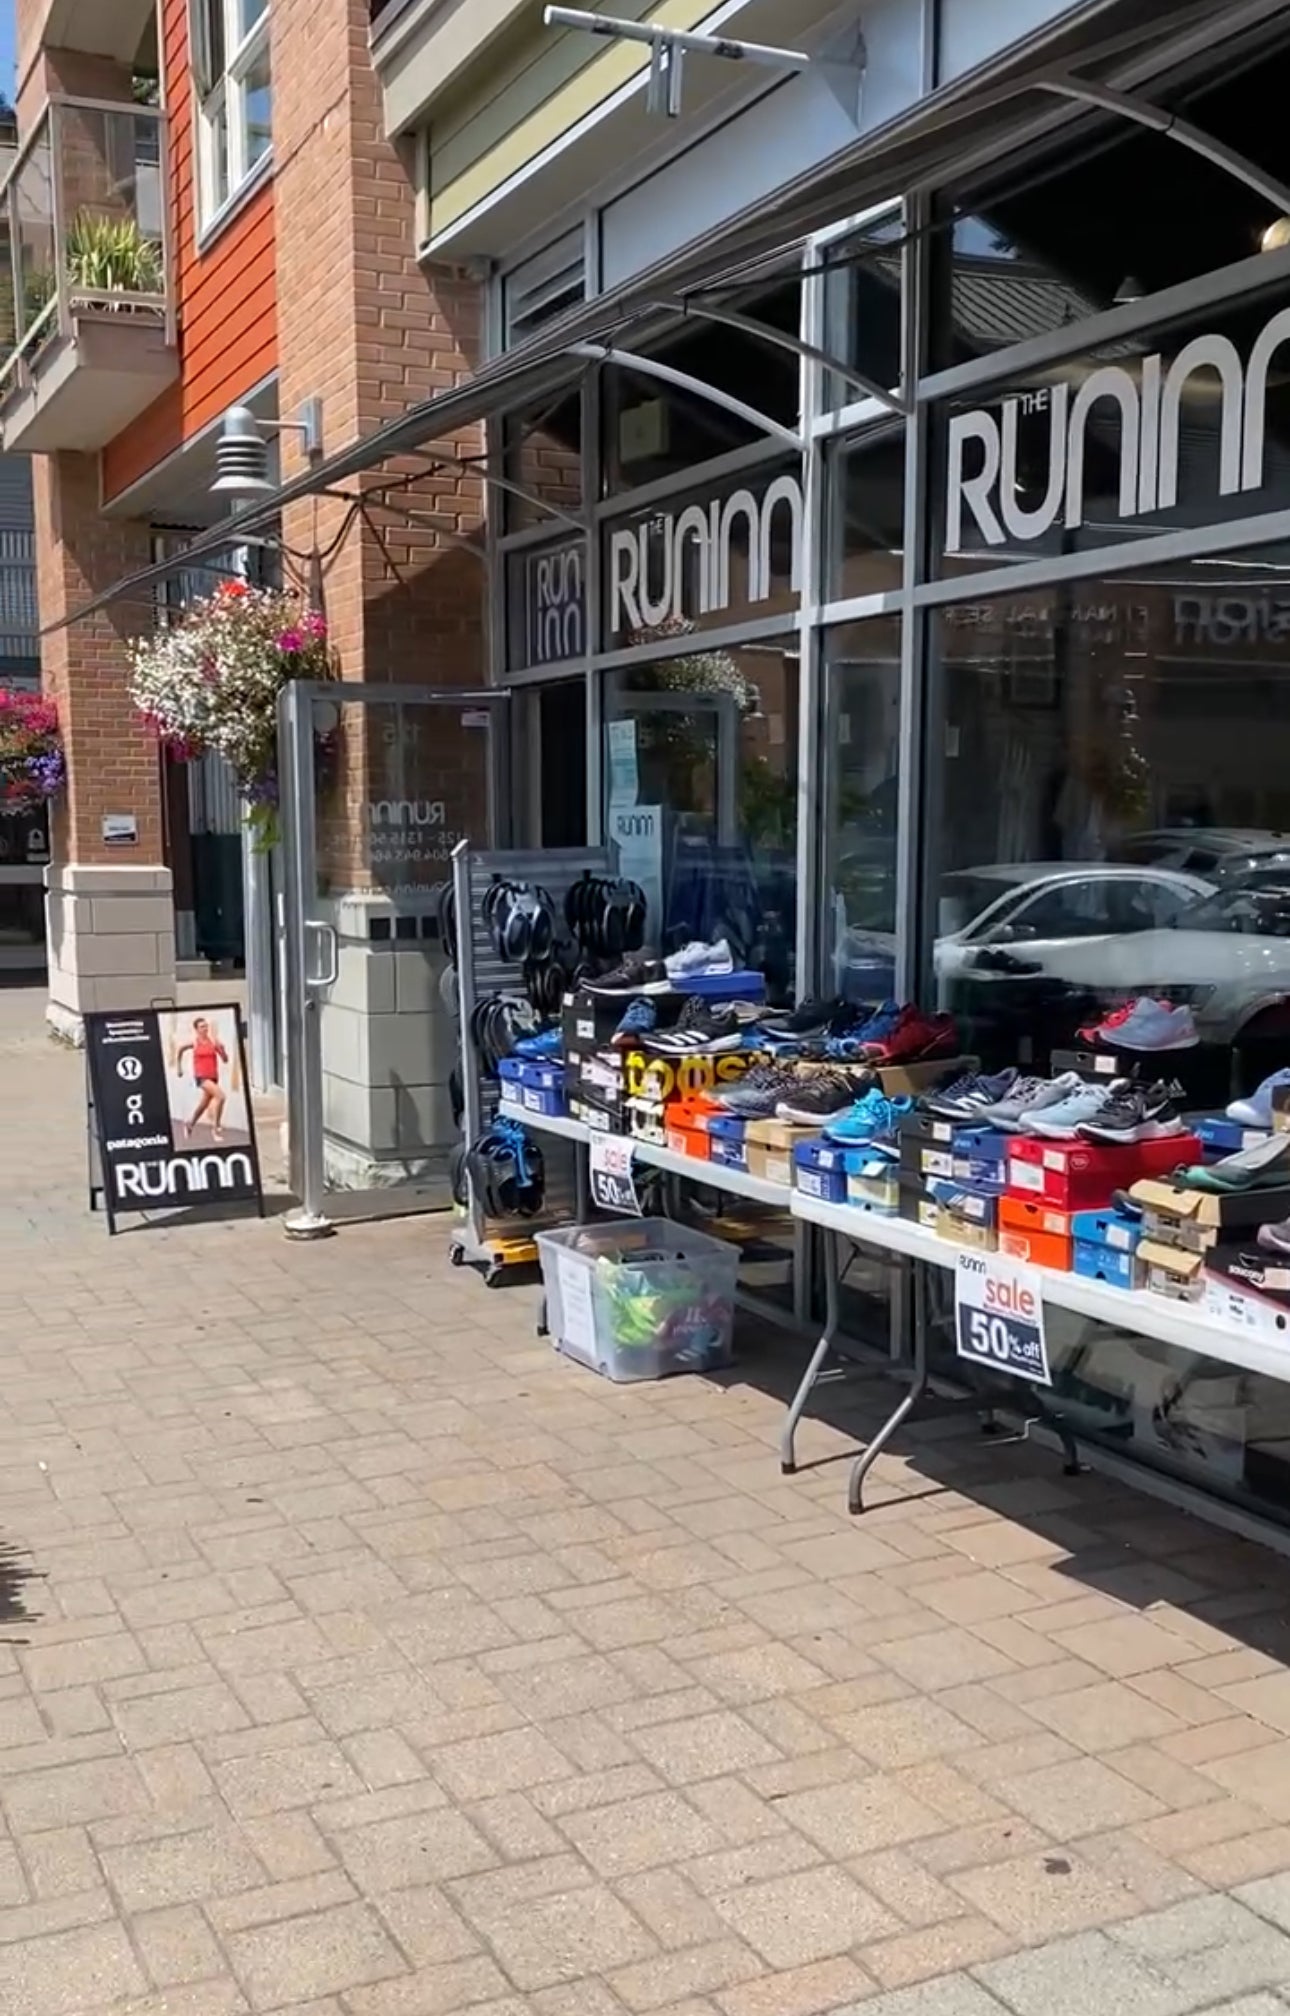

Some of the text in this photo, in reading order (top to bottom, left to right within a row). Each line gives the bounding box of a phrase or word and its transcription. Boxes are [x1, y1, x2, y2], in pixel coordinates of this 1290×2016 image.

[1021, 388, 1049, 416] THE
[107, 1134, 168, 1151] patagonia
[985, 1277, 1035, 1315] sale
